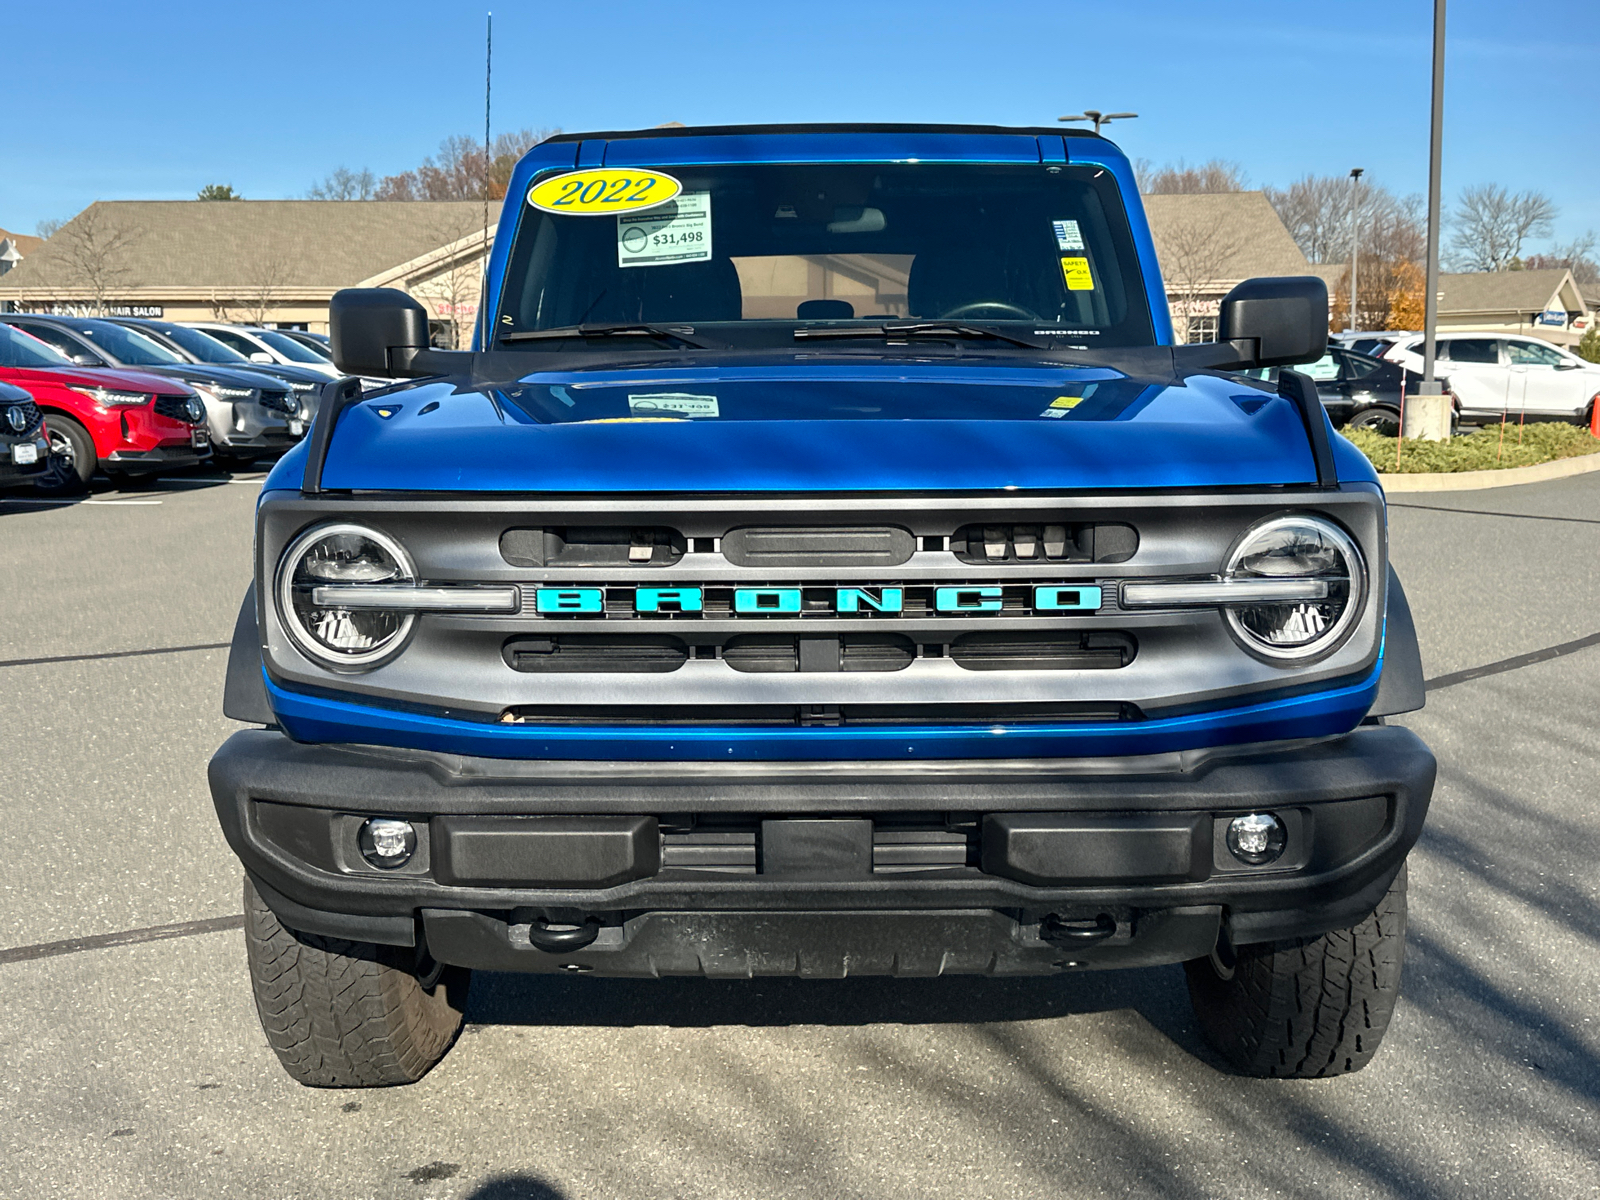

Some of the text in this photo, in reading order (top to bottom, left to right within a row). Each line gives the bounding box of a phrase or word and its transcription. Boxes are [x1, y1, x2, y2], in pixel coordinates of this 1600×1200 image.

[551, 177, 657, 206] 2022
[653, 232, 703, 247] $31,498
[110, 306, 131, 316] HAIR
[132, 306, 162, 316] SALON
[536, 586, 1103, 613] BRONCO
